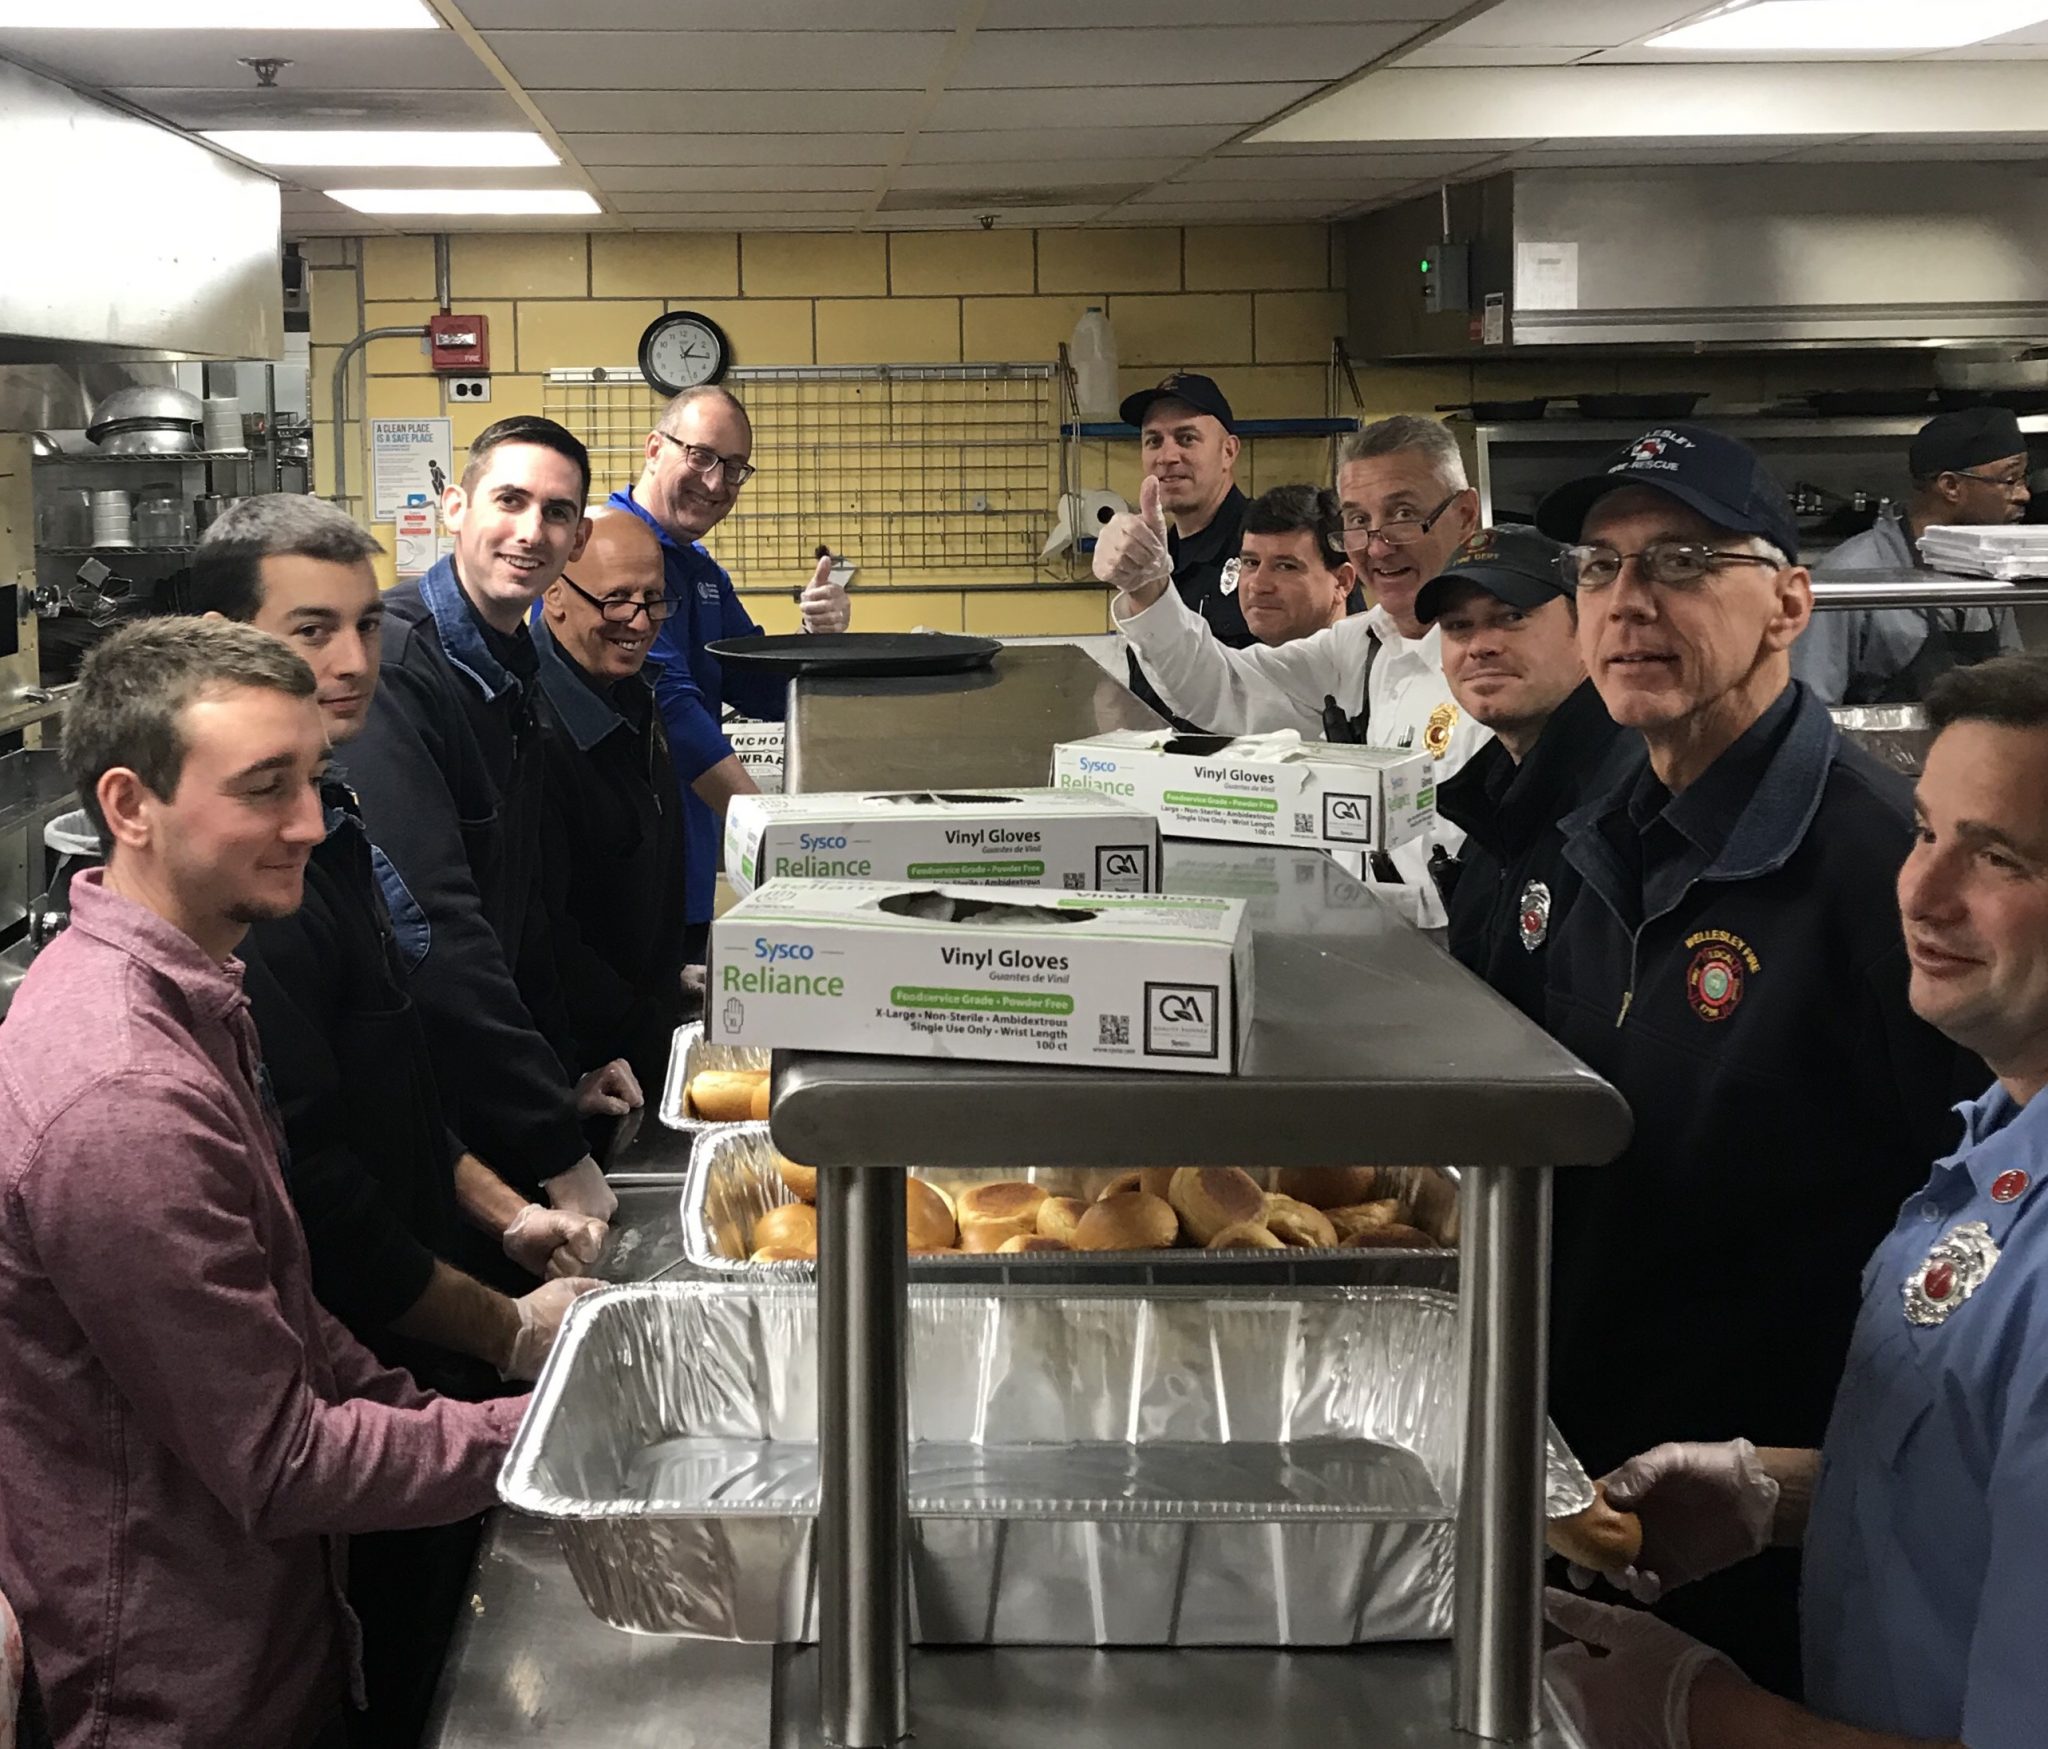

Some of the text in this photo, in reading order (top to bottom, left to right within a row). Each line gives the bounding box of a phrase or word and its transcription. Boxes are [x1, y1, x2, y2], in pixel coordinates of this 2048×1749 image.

[701, 341, 706, 349] 2
[376, 424, 430, 433] A CLEAN PLACE
[376, 433, 434, 443] IS A SAFE PLACE
[735, 736, 785, 746] NCHO
[1080, 757, 1117, 773] Sysco
[1194, 766, 1275, 784] Vinyl Gloves
[1061, 773, 1135, 797] Reliance
[1160, 804, 1180, 813] Large
[1176, 813, 1275, 829] Single Use Only Wrist Length
[945, 828, 1041, 848] Vinyl Gloves
[1254, 828, 1268, 836] 100
[800, 833, 847, 853] Sysco
[776, 855, 871, 878] Reliance
[755, 937, 814, 963] Sysco
[941, 947, 1069, 971] Vinyl Gloves
[723, 965, 844, 997] Reliance
[989, 971, 1070, 984] Guantes de Vinil
[896, 991, 1069, 1010] Foodservice Grade Powder Free
[875, 1008, 1069, 1027] X-Large Non-Sterile Ambidextrous
[910, 1021, 1068, 1041] Single Use Only Wrist Length
[1036, 1040, 1068, 1051] 100 ct
